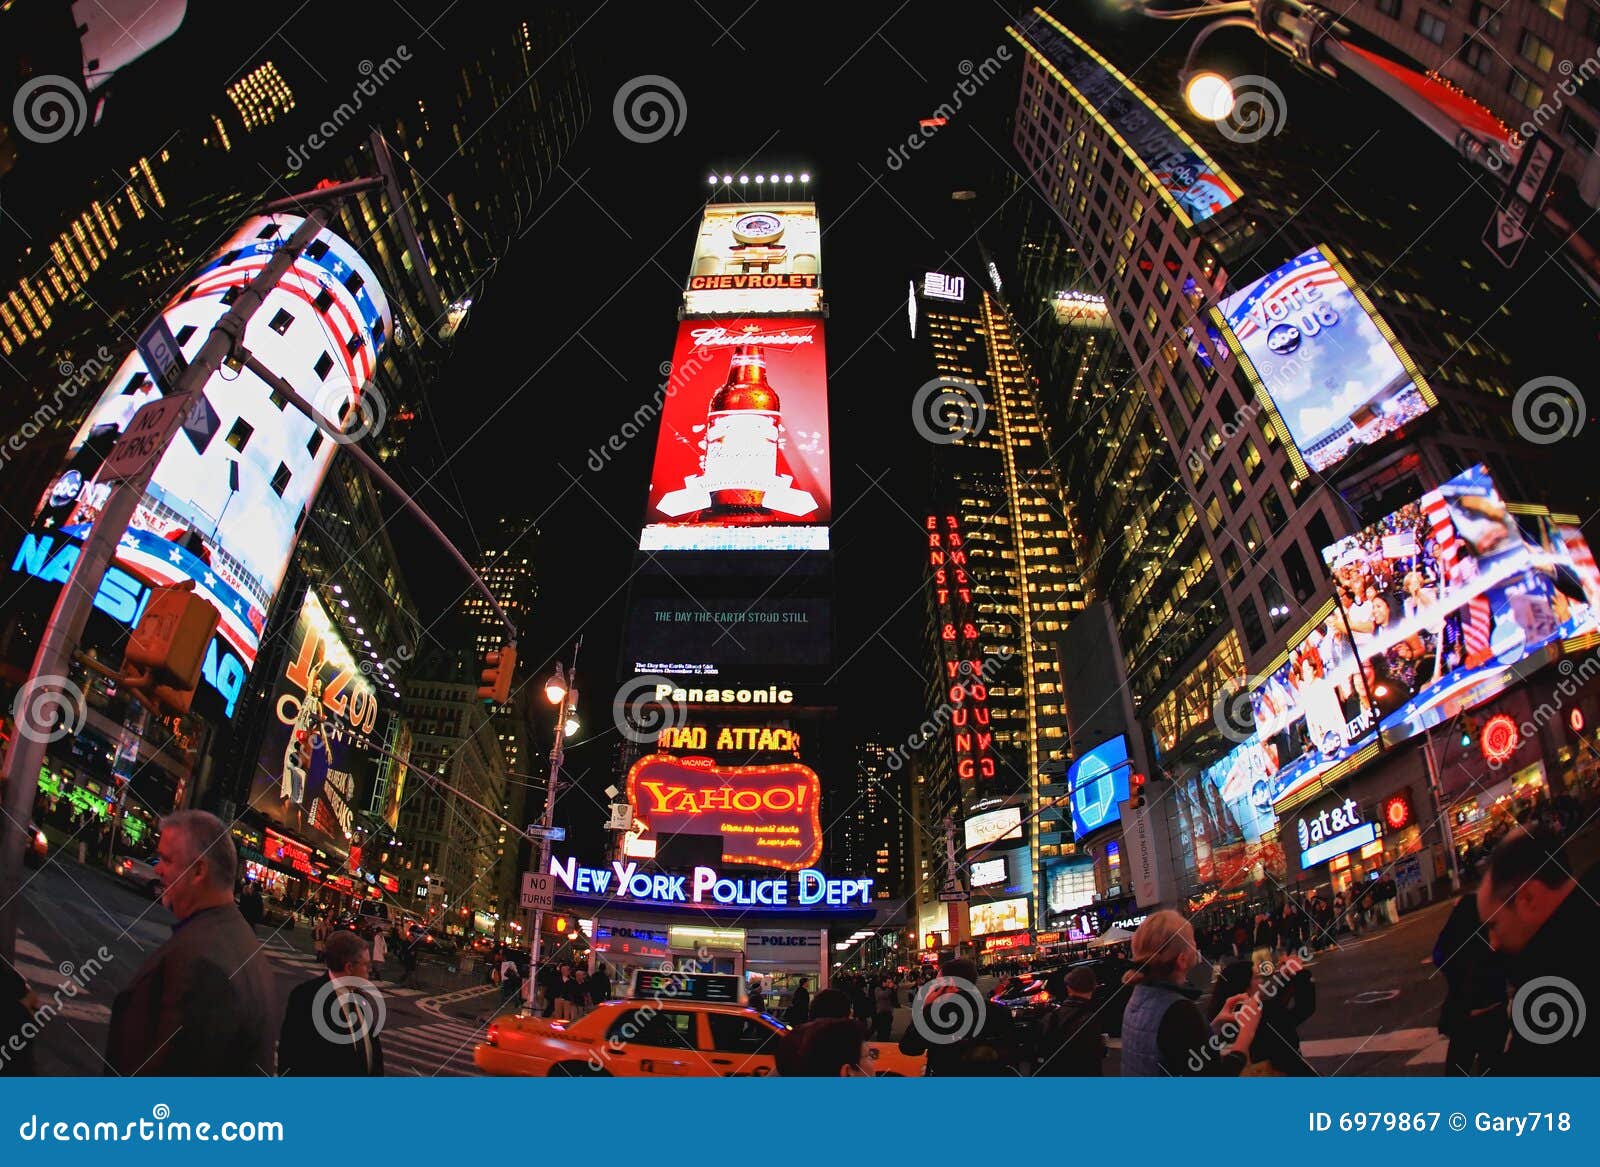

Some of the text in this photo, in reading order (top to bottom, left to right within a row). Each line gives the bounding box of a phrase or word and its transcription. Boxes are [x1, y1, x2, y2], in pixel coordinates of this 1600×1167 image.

[1139, 125, 1187, 172] VOTE
[1173, 164, 1196, 187] abc
[1525, 149, 1544, 190] WAY
[691, 274, 816, 290] CHEVROLET
[1246, 280, 1322, 330] VOTE
[690, 326, 814, 346] Budweiser
[1268, 302, 1339, 351] abc 08
[155, 342, 181, 387] ONE
[136, 407, 166, 430] NO
[221, 568, 241, 592] PARK
[654, 611, 809, 623] THE DAY THE EARTH STOOD STILL
[926, 515, 975, 778] ERNST & YOUNG
[655, 684, 793, 704] Panasonic
[681, 759, 713, 768] VACANCY
[640, 781, 808, 813] YAHOO!
[1310, 798, 1360, 842] at&t
[1140, 840, 1151, 880] THOMSON
[530, 877, 547, 891] NO
[549, 855, 874, 905] NEW YORK POLICE DEPT
[523, 893, 552, 906] TURNS
[611, 928, 656, 941] POLICE
[760, 936, 807, 946] POLICE
